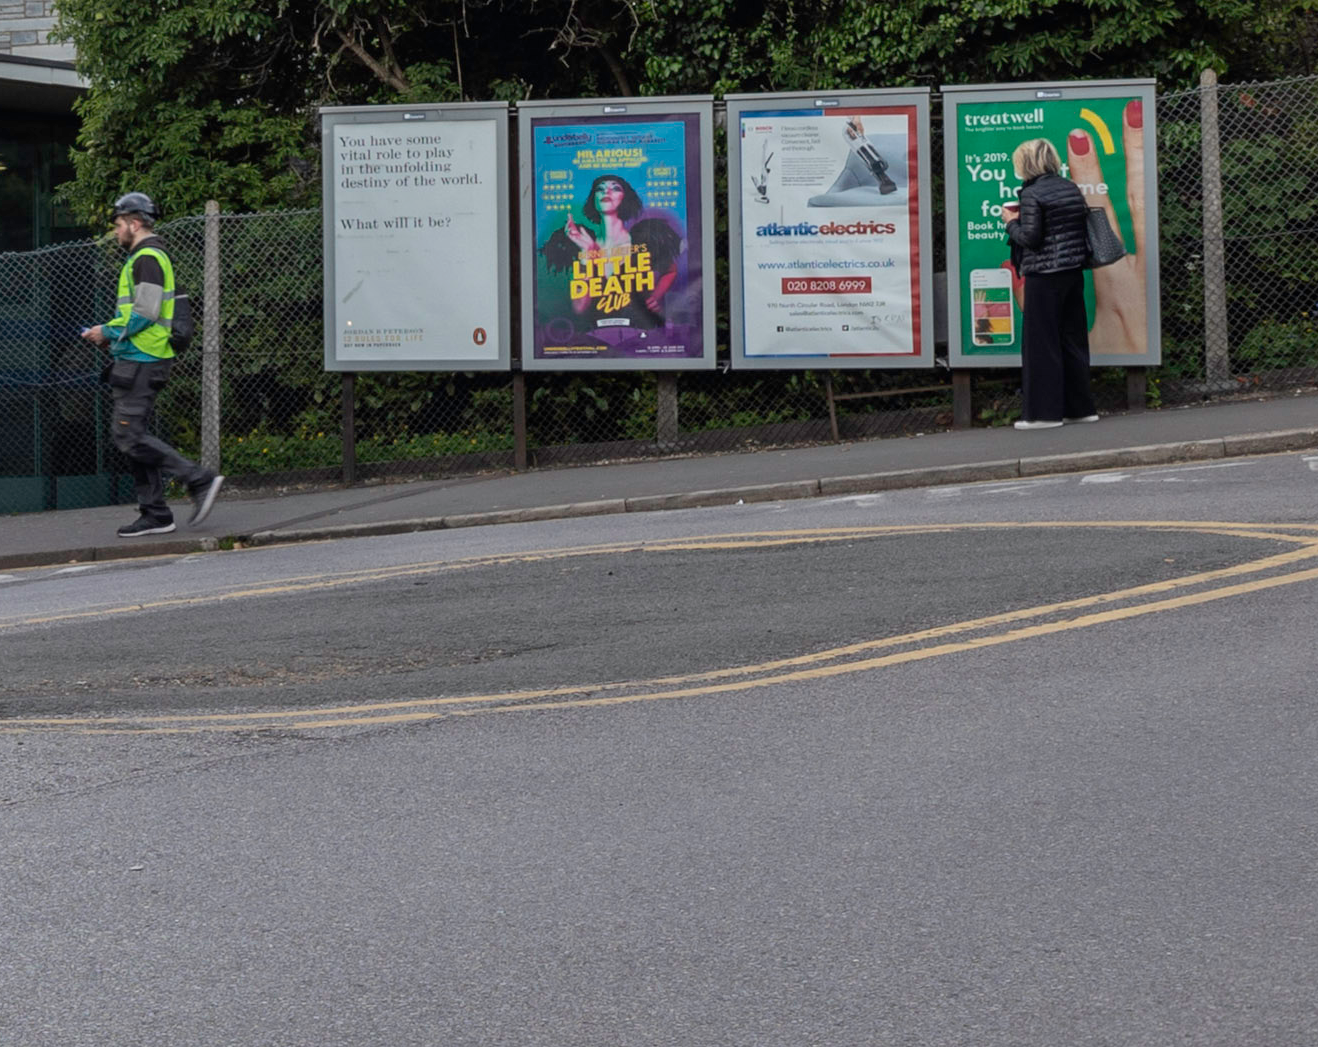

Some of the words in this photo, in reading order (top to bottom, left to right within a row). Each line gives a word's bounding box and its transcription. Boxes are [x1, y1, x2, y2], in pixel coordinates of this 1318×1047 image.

[965, 108, 1044, 126] treatwell
[339, 136, 365, 147] You
[370, 136, 402, 146] have
[406, 135, 441, 145] some
[340, 150, 371, 161] vital
[376, 149, 402, 160] role
[407, 150, 421, 159] to
[425, 147, 454, 159] play
[577, 148, 643, 158] HILARIOUS!
[965, 155, 981, 163] It's
[984, 153, 1010, 163] 2019.
[341, 164, 354, 175] in
[359, 163, 380, 174] the
[385, 162, 451, 173] unfolding
[966, 164, 1006, 182] You
[341, 177, 390, 188] destiny
[395, 176, 410, 187] of
[414, 175, 435, 186] the
[441, 174, 482, 185] world.
[340, 219, 378, 230] What
[384, 217, 408, 229] will
[413, 217, 423, 228] it
[428, 216, 451, 227] be?
[967, 222, 994, 230] Book
[967, 231, 1005, 240] beauty
[573, 251, 651, 279] LITTLE
[757, 258, 895, 270] www.atlanticelectrics.co.uk
[570, 271, 654, 300] DEATH
[787, 281, 807, 291] 020
[810, 281, 836, 290] 8208
[839, 281, 866, 290] 6999
[596, 293, 631, 314] CLUB
